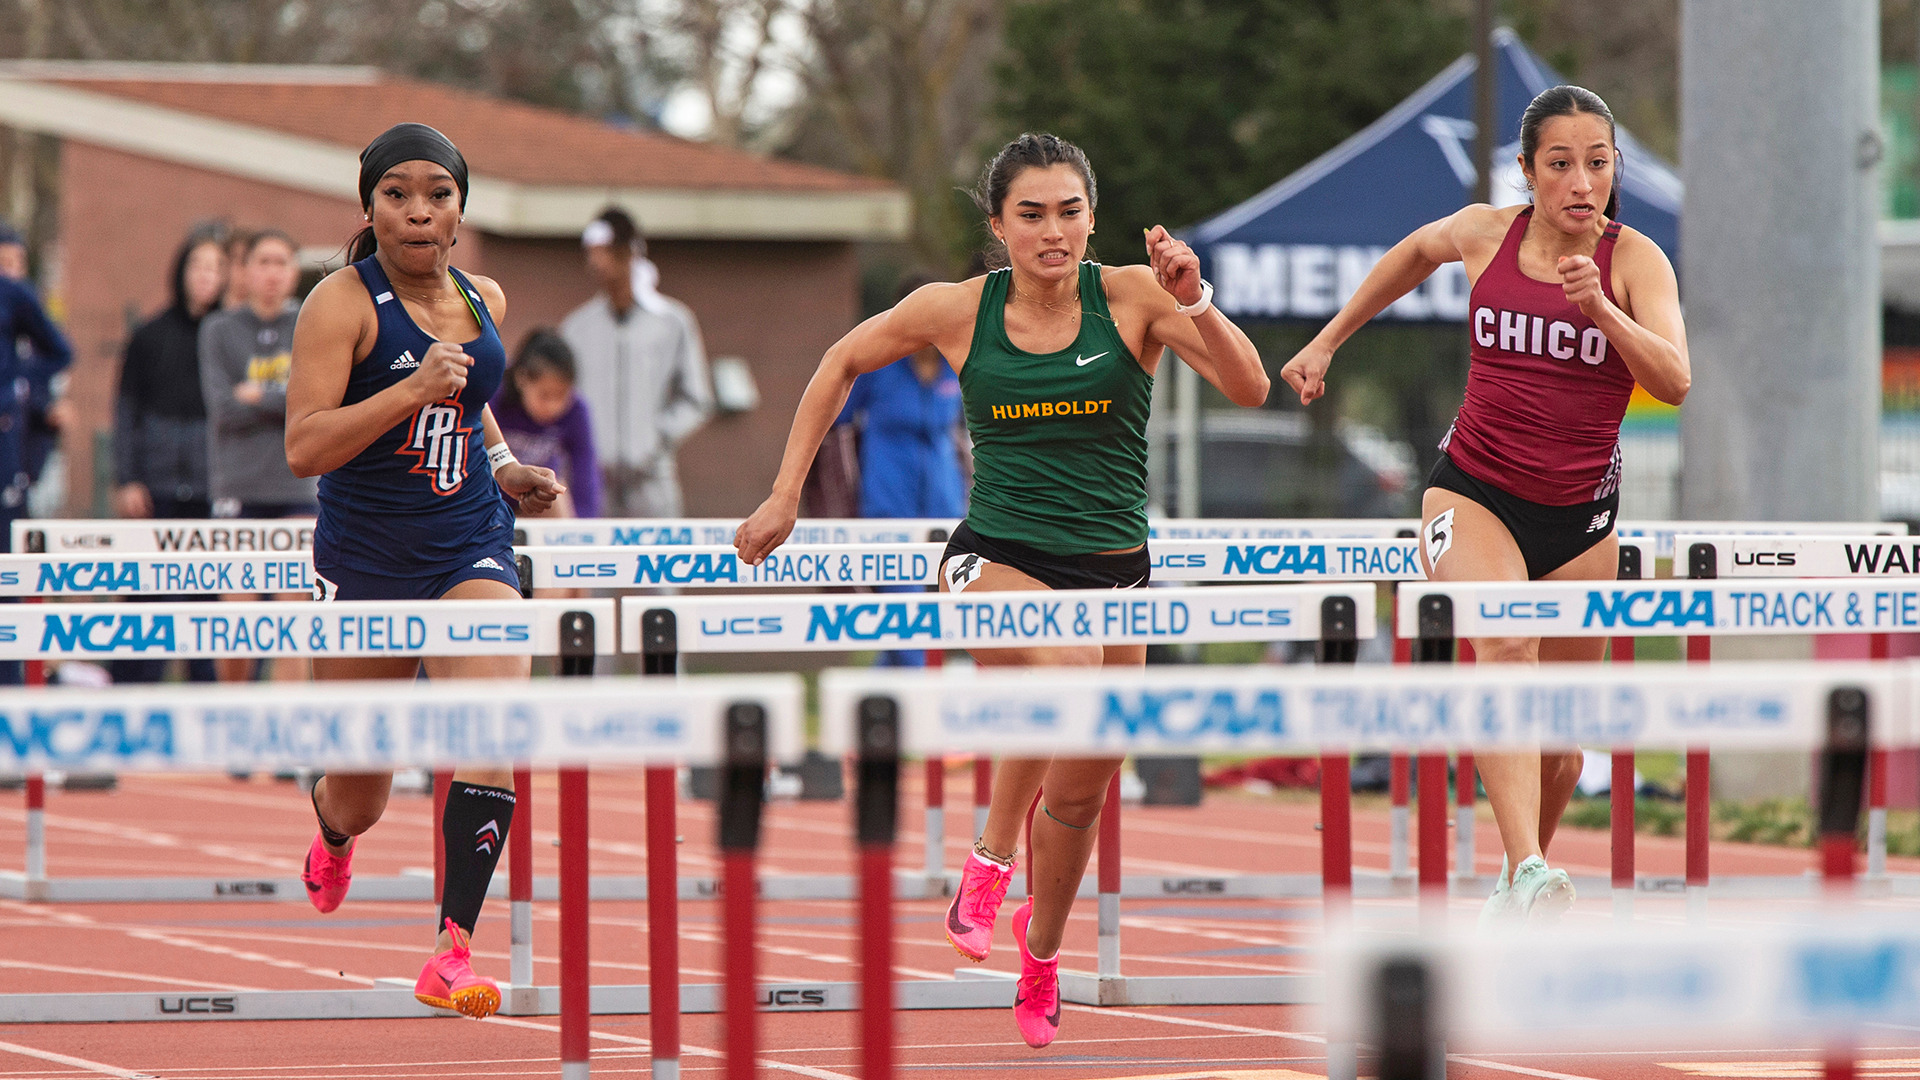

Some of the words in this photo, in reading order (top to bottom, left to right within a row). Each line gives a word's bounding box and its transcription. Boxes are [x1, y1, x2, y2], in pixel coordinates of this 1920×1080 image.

[1474, 306, 1608, 366] CHICO
[390, 361, 420, 370] adidas
[991, 399, 1113, 420] HUMBOLDT
[612, 526, 693, 545] NCAA
[703, 527, 736, 545] TRA
[1431, 514, 1447, 564] 5
[554, 563, 617, 578] UCS
[633, 554, 738, 584] NCAA
[838, 554, 854, 582] &
[862, 553, 928, 582] FIELD
[1222, 545, 1326, 575] NCAA
[1336, 546, 1419, 574] TRACK
[1735, 552, 1796, 566] UCS
[35, 561, 141, 591] NCAA
[150, 563, 232, 590] TRACK
[241, 562, 257, 589] &
[264, 562, 314, 589] FIEL
[701, 617, 783, 636] UCS
[805, 602, 942, 643] NCAA
[955, 602, 1062, 638] TRACK
[1073, 602, 1093, 637] &
[1104, 601, 1190, 636] FIELD
[1211, 609, 1291, 627] UCS
[1480, 602, 1560, 619] UCS
[1582, 590, 1716, 628] NCAA
[1730, 592, 1833, 627] TRACK
[1845, 592, 1863, 626] &
[1875, 591, 1920, 626] FIE
[38, 614, 176, 652] NCAA
[190, 616, 298, 652] TRACK
[308, 616, 328, 651] &
[340, 616, 426, 651] FIELD
[448, 624, 530, 642] UCS
[1096, 689, 1286, 741] NCAA
[1312, 687, 1450, 738] TRACK
[1519, 685, 1647, 738] FIELD
[0, 709, 175, 758] NCAA
[201, 706, 345, 757] TRACK
[411, 703, 541, 757] FIELD
[160, 997, 235, 1014] UCS
